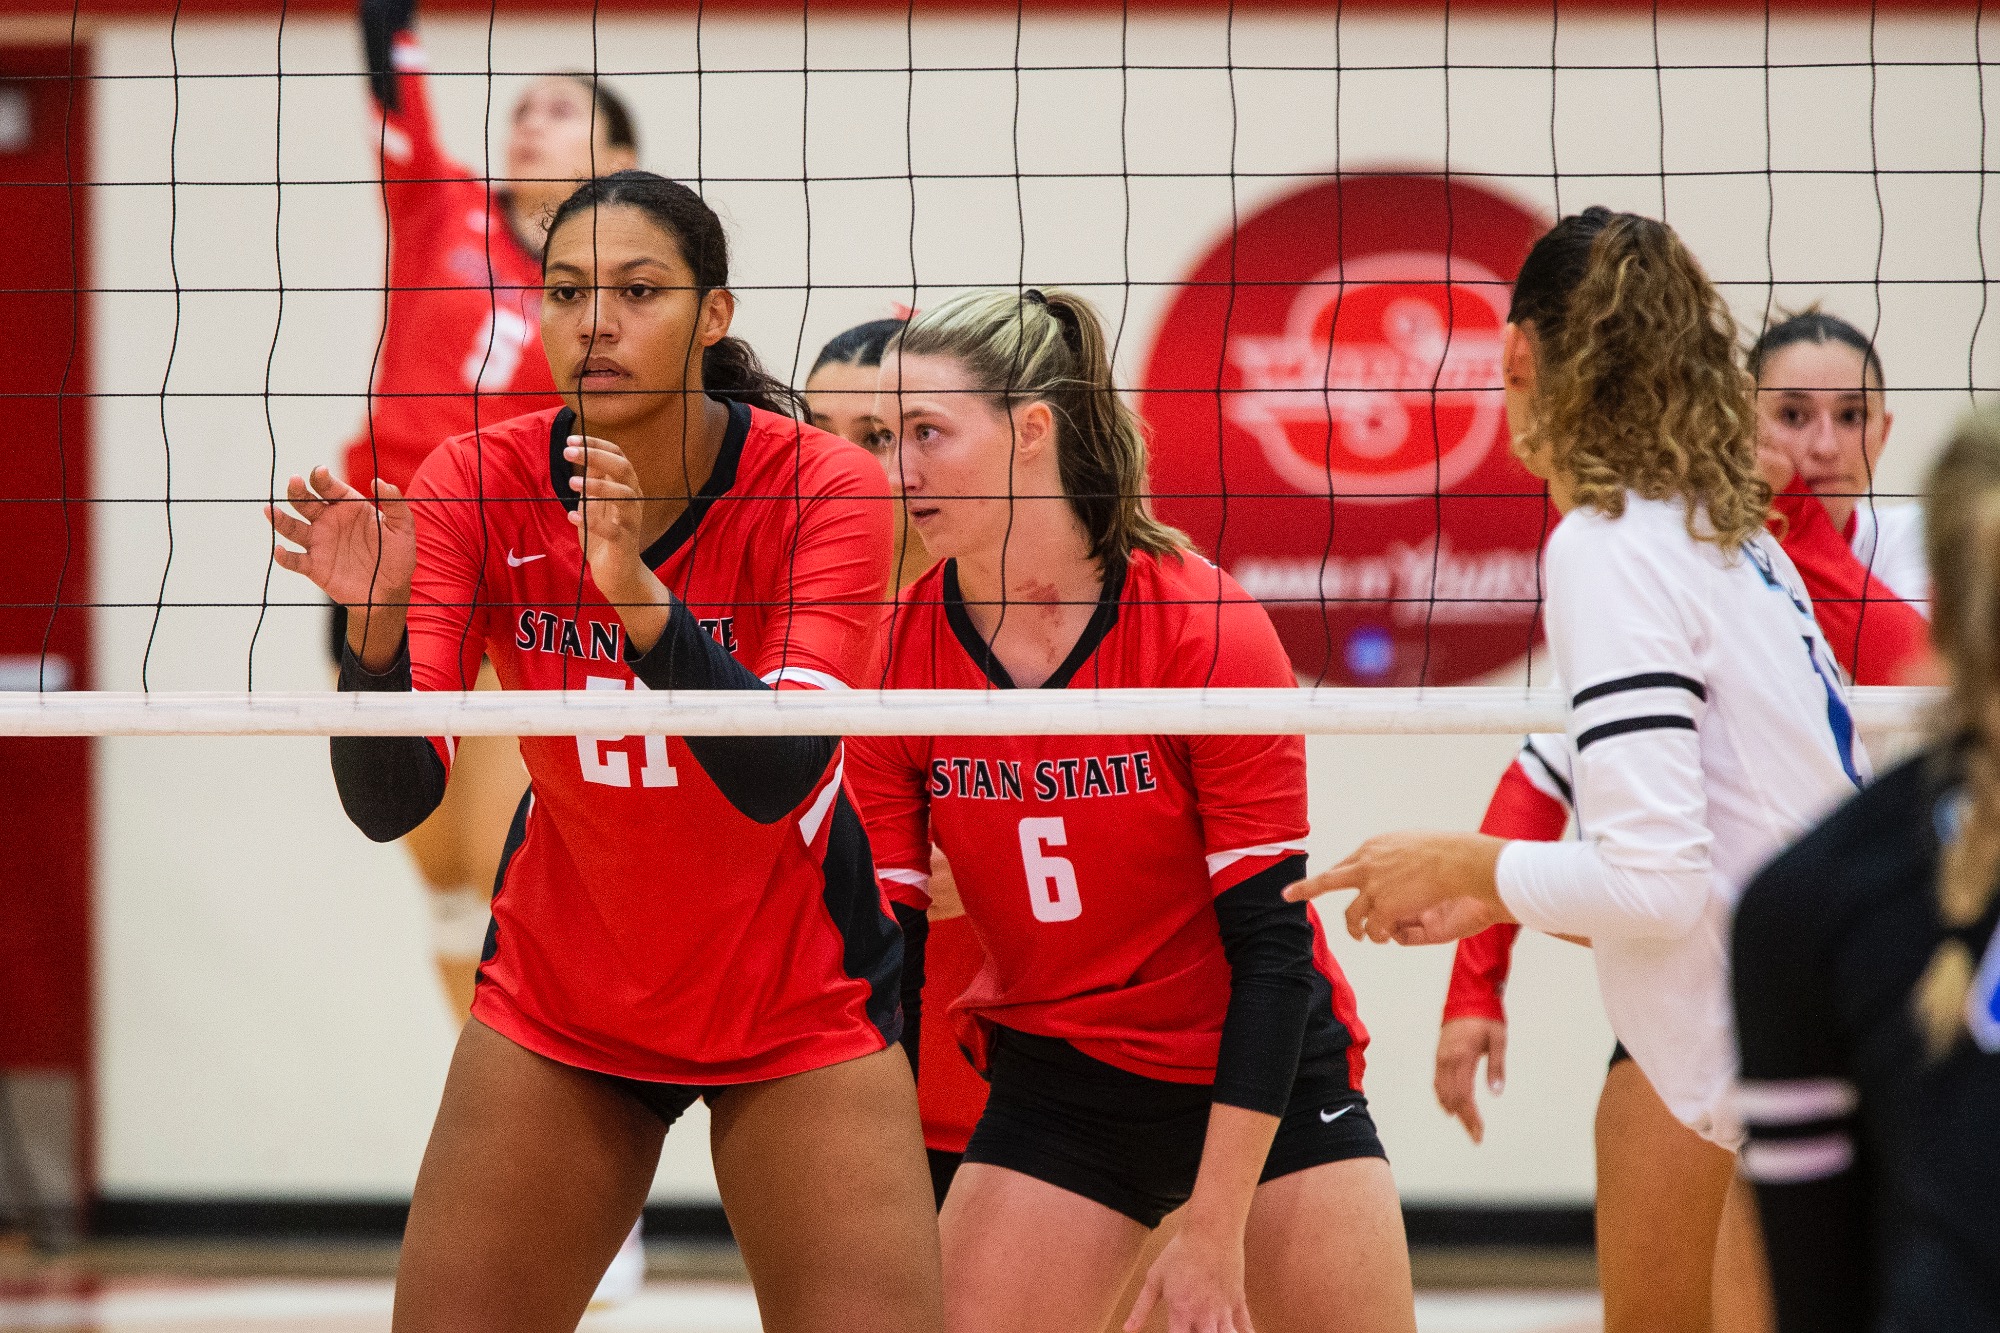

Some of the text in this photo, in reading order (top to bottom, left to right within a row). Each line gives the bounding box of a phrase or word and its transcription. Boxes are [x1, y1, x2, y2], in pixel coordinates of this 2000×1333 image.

[515, 608, 620, 663] STAN
[931, 750, 1157, 801] STAN STATE
[1018, 816, 1083, 923] 6
